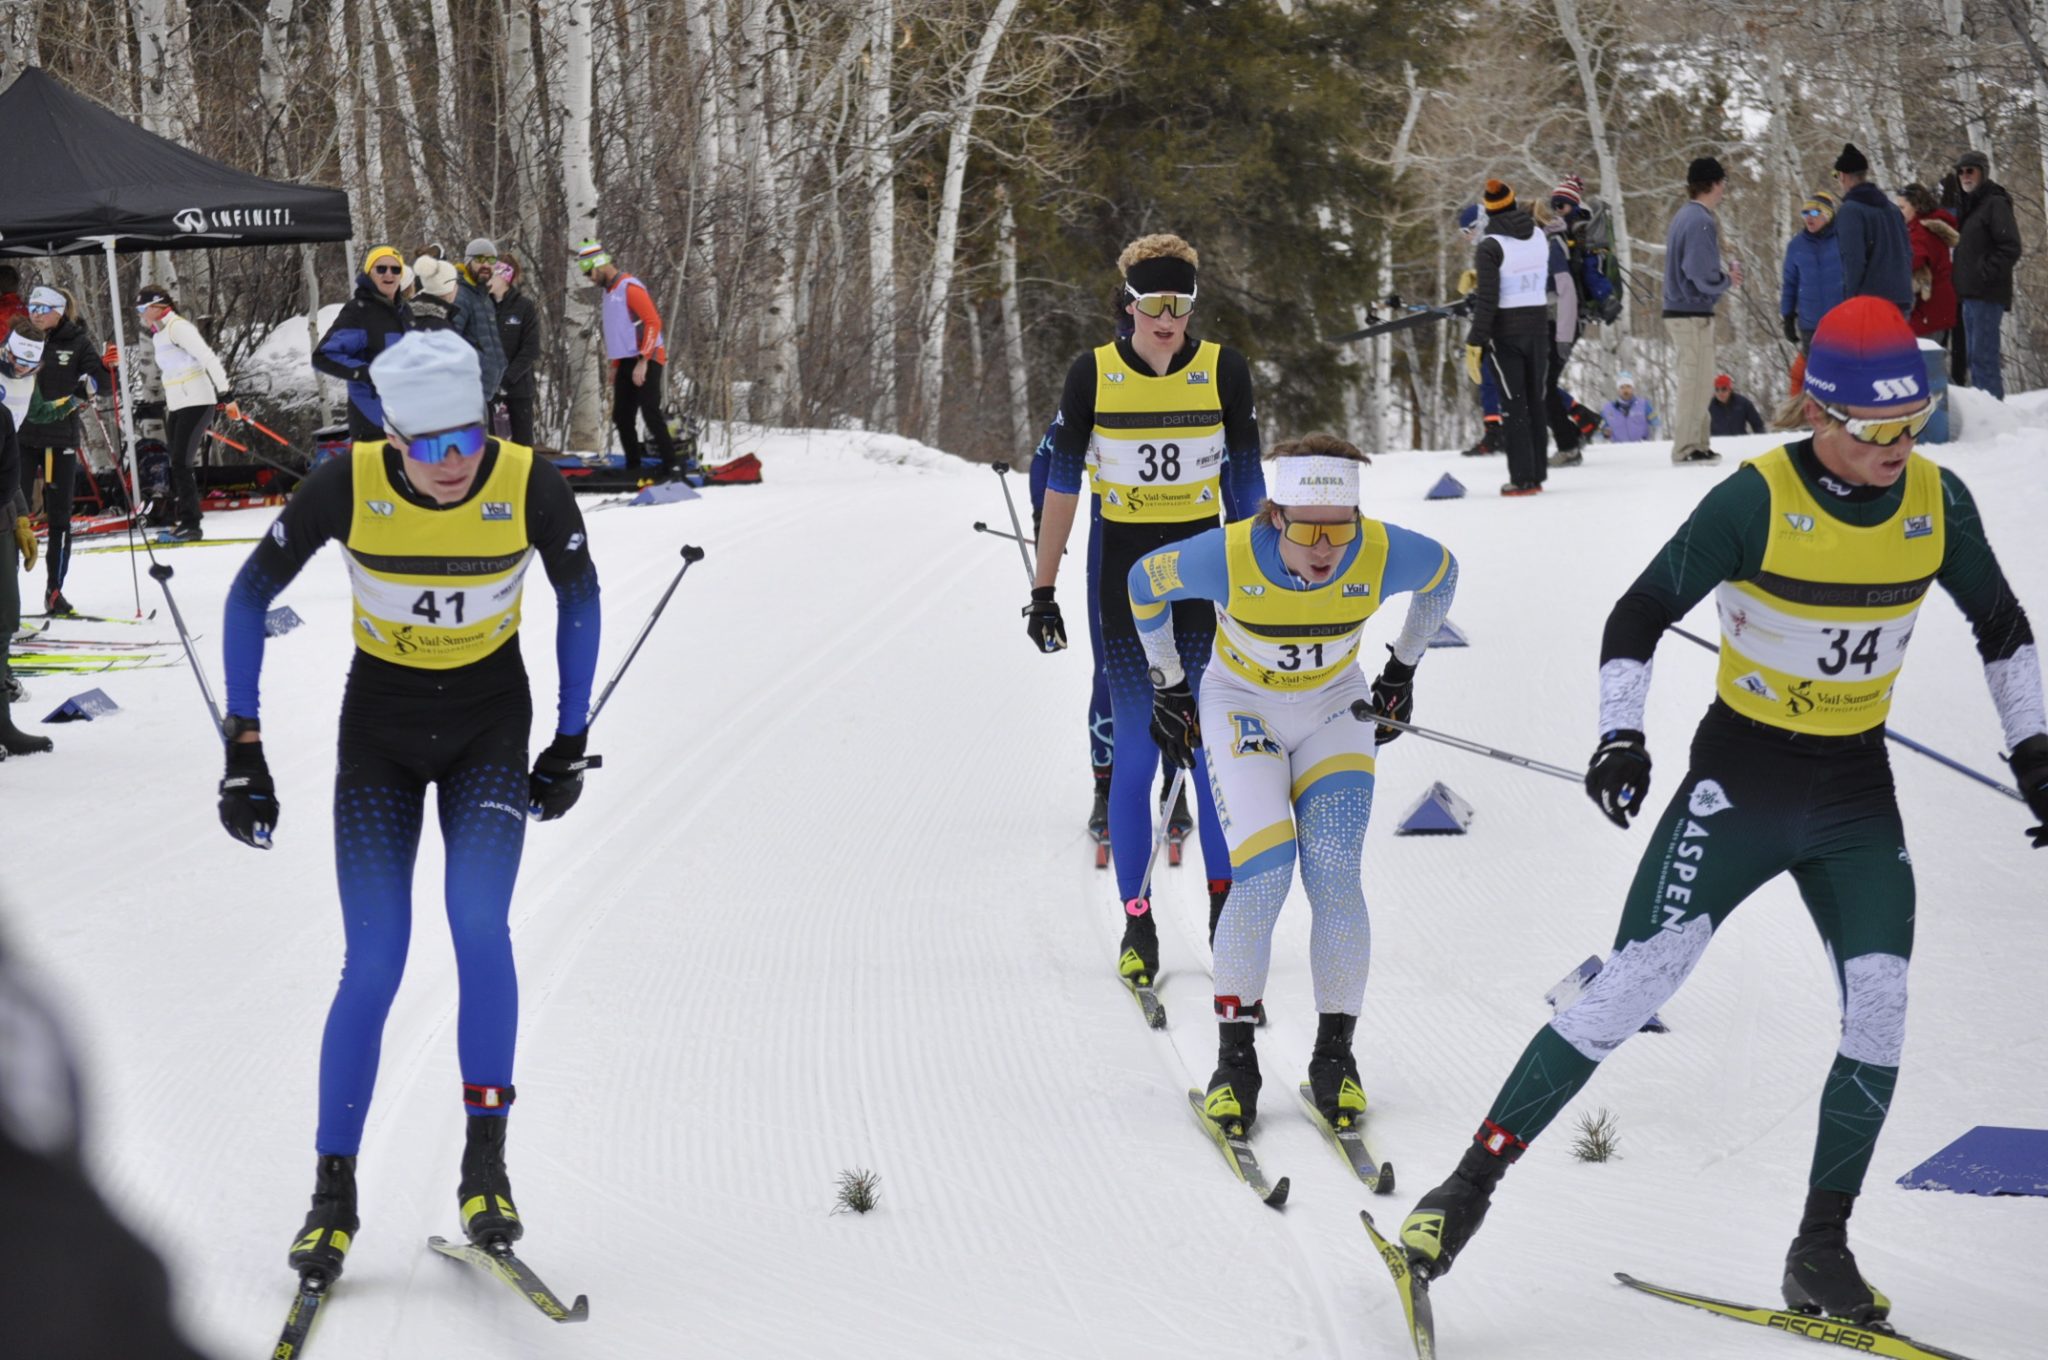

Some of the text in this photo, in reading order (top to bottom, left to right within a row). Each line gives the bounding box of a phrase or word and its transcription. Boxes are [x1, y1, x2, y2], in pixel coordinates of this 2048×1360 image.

[211, 208, 290, 228] INFINITI
[1162, 413, 1219, 427] partners
[1137, 442, 1181, 482] 38
[1299, 476, 1345, 487] ALASKA
[1346, 583, 1365, 593] Vail
[412, 590, 466, 624] 41
[1277, 643, 1324, 671] 31
[1817, 627, 1882, 676] 34
[1660, 819, 1710, 935] ASPEN
[1767, 1314, 1876, 1352] FISCHER
